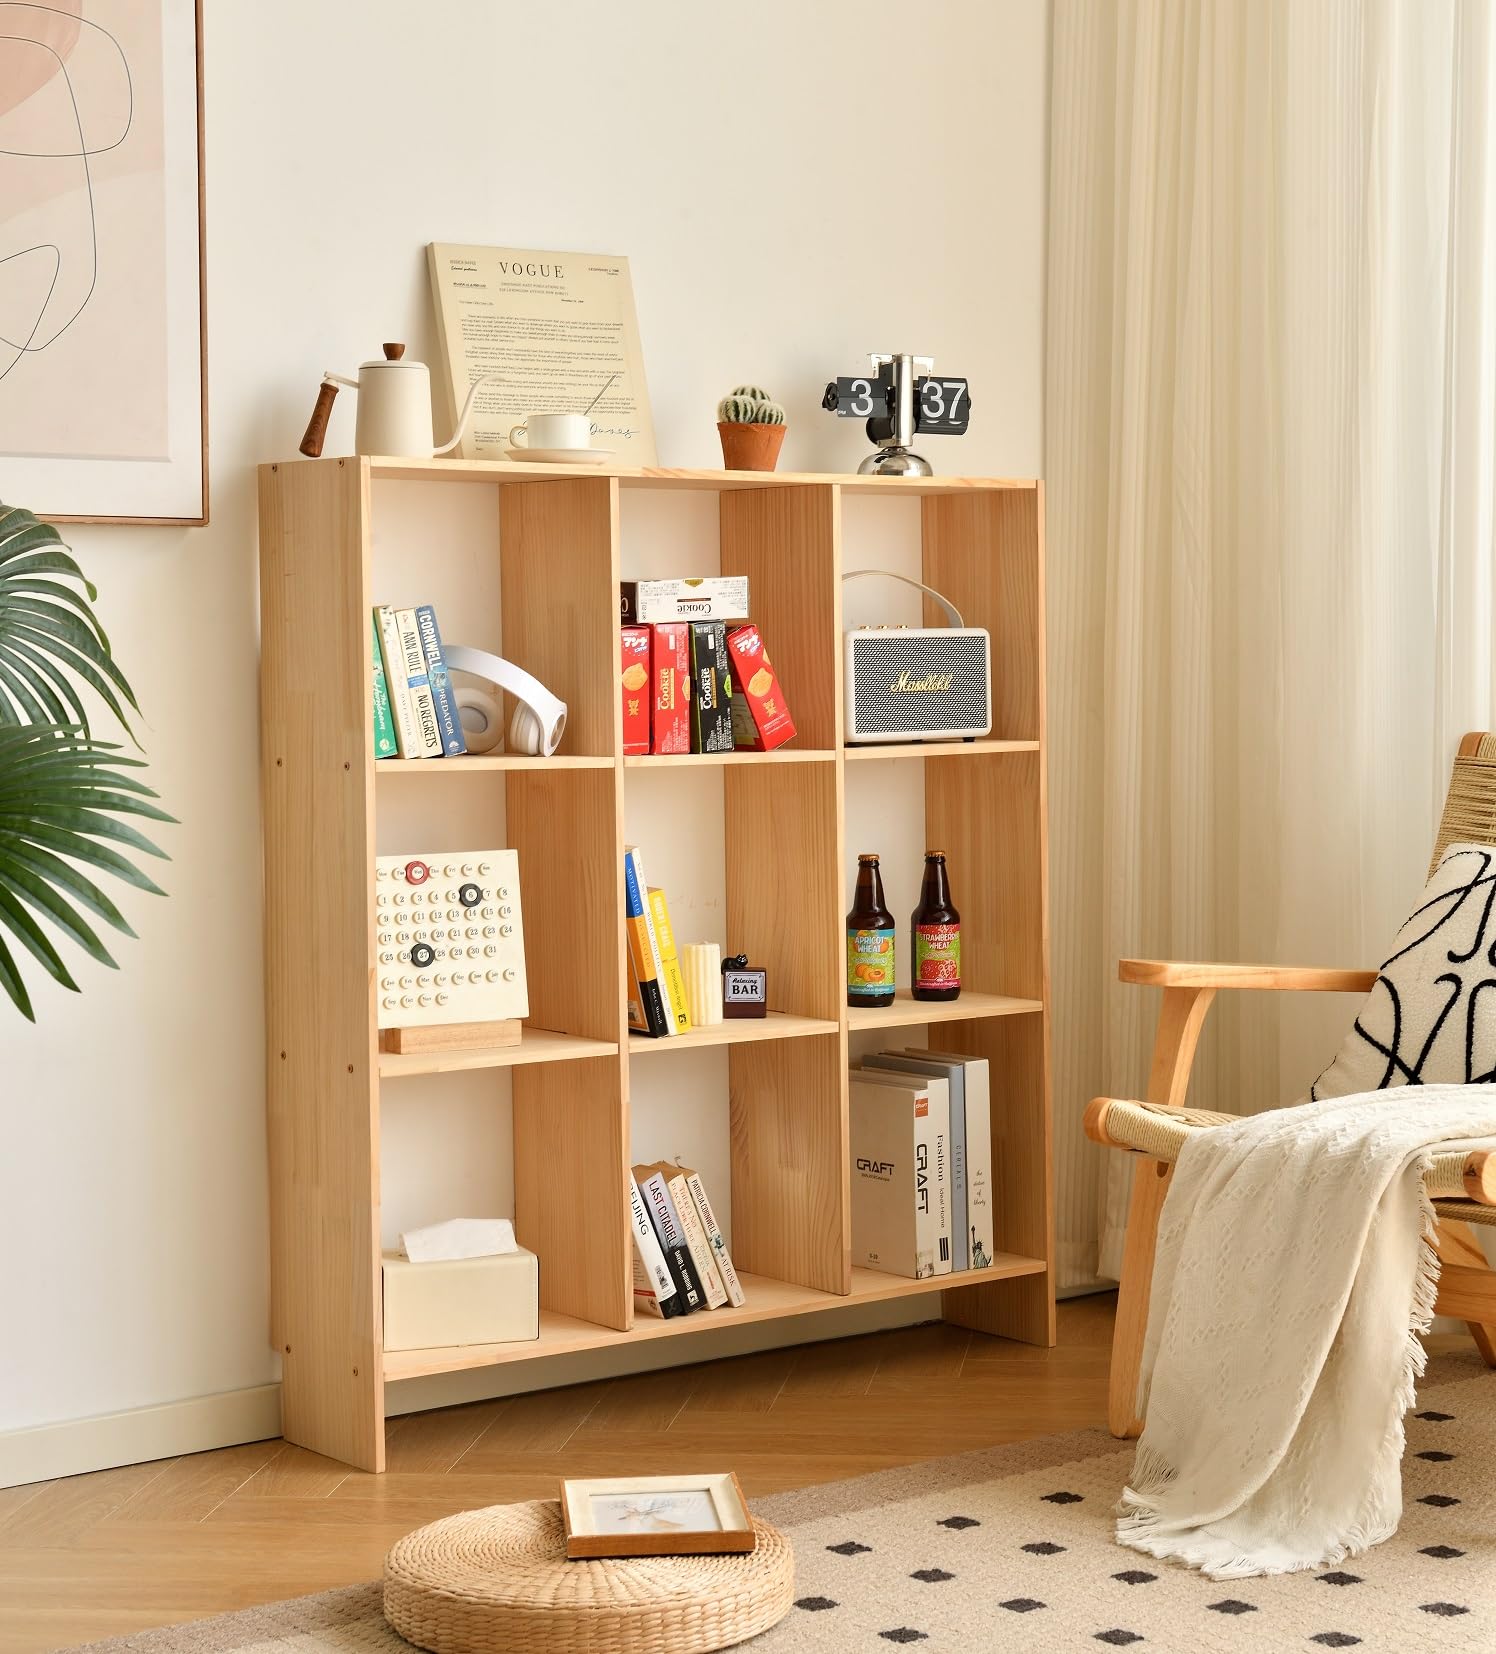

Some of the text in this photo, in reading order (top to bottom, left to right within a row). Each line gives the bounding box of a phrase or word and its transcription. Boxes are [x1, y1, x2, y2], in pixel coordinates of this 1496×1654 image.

[499, 261, 565, 279] VOGUE
[850, 379, 874, 416] 3
[922, 381, 967, 419] 37
[402, 631, 414, 652] ANN
[419, 614, 443, 670] CORNWELL
[407, 652, 422, 676] RULE
[417, 694, 428, 708] NO
[438, 688, 455, 736] PREDATOR
[420, 707, 438, 748] REGRETS
[855, 936, 885, 944] APRICOT
[857, 944, 881, 953] WHEAT
[928, 942, 950, 950] WHEAT
[732, 985, 759, 994] BAR
[855, 1158, 895, 1176] CRAFT
[936, 1134, 945, 1182] Fashion
[916, 1143, 929, 1214] CRAFT
[631, 1183, 649, 1236] EIJING
[649, 1180, 665, 1207] LAST
[658, 1205, 678, 1246] CITADEL
[691, 1180, 717, 1236] PATRICIA CORNWELL
[724, 1268, 736, 1287] RISK
